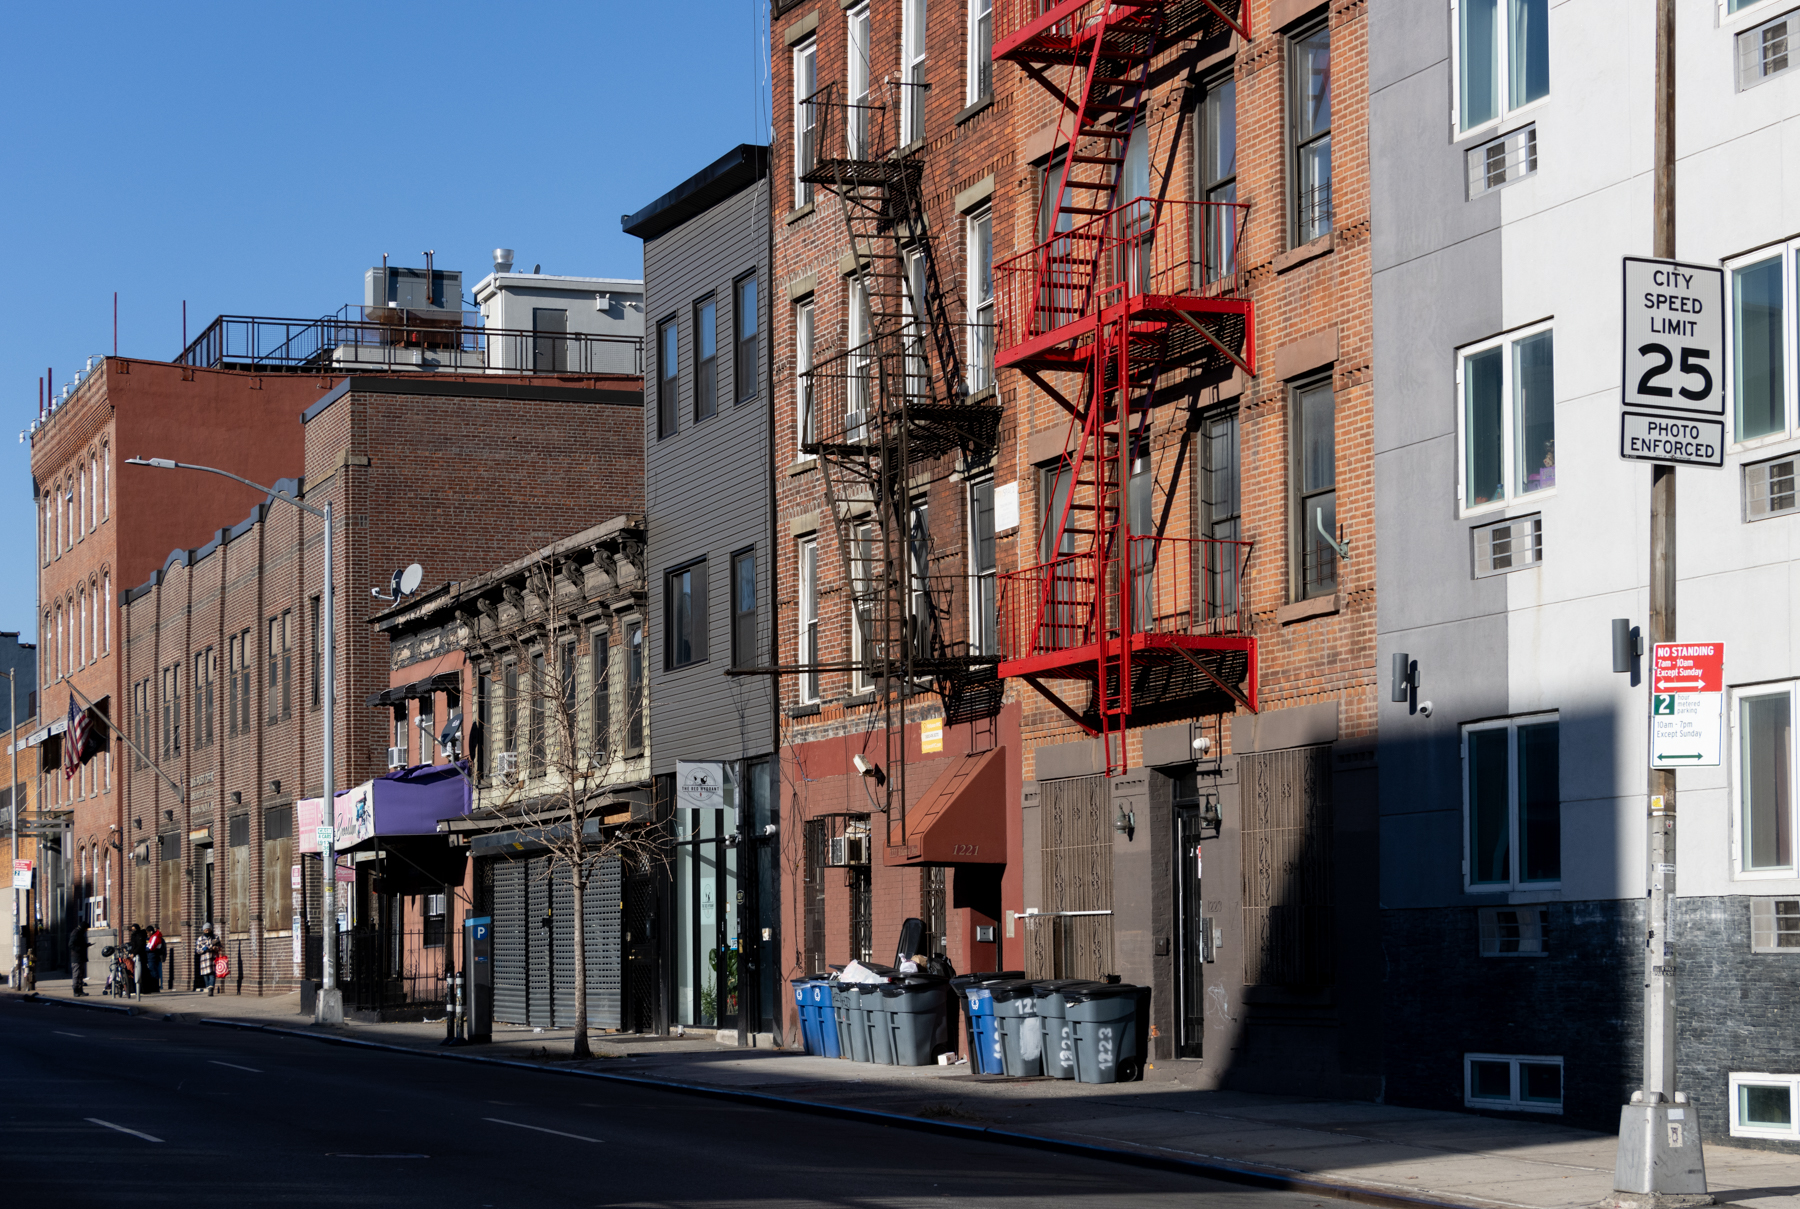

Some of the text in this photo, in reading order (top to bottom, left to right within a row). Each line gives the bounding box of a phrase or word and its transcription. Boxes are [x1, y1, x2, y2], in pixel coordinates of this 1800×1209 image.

[1653, 270, 1694, 290] CITY
[1644, 292, 1703, 314] SPEED
[1651, 316, 1698, 337] LIMIT
[1637, 342, 1713, 401] 25
[1648, 421, 1699, 440] PHOTO
[1631, 437, 1715, 458] ENFORCED
[1657, 646, 1715, 657] NO STANDING
[1657, 659, 1671, 668] 7am
[1676, 659, 1694, 667] 10am
[1657, 668, 1703, 677] Except Sunday
[1658, 694, 1671, 714] 2
[1656, 721, 1673, 729] 10am
[1679, 721, 1693, 729] 7pm
[1656, 730, 1702, 739] Except Sunday
[953, 844, 979, 856] 1221
[477, 926, 485, 939] P
